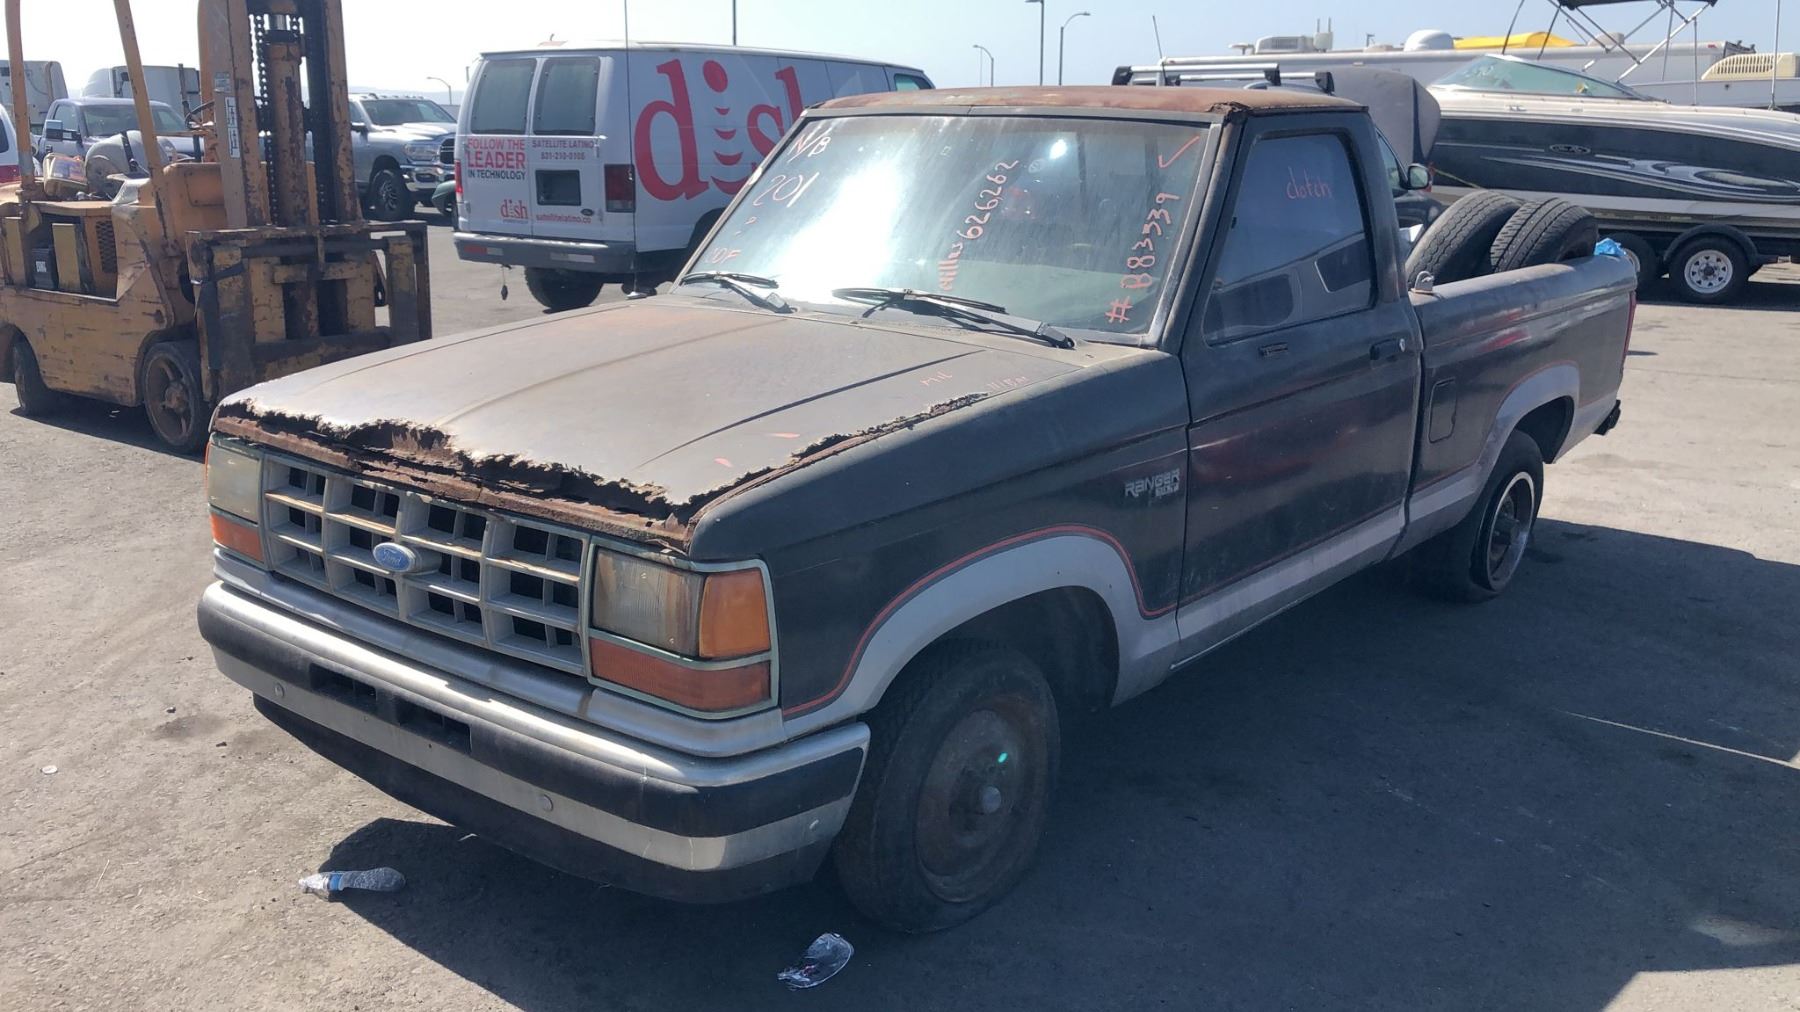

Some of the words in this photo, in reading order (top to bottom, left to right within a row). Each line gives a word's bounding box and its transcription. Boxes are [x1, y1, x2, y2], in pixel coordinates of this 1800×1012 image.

[467, 138, 504, 149] FOLLOW
[507, 139, 525, 150] THE
[532, 139, 567, 148] SATELLITE
[569, 140, 594, 149] LATINO
[467, 151, 526, 169] LEADER
[468, 169, 475, 178] IN
[477, 169, 526, 180] TECHNOLOGY
[501, 199, 528, 219] dish
[1125, 469, 1179, 497] RANGER
